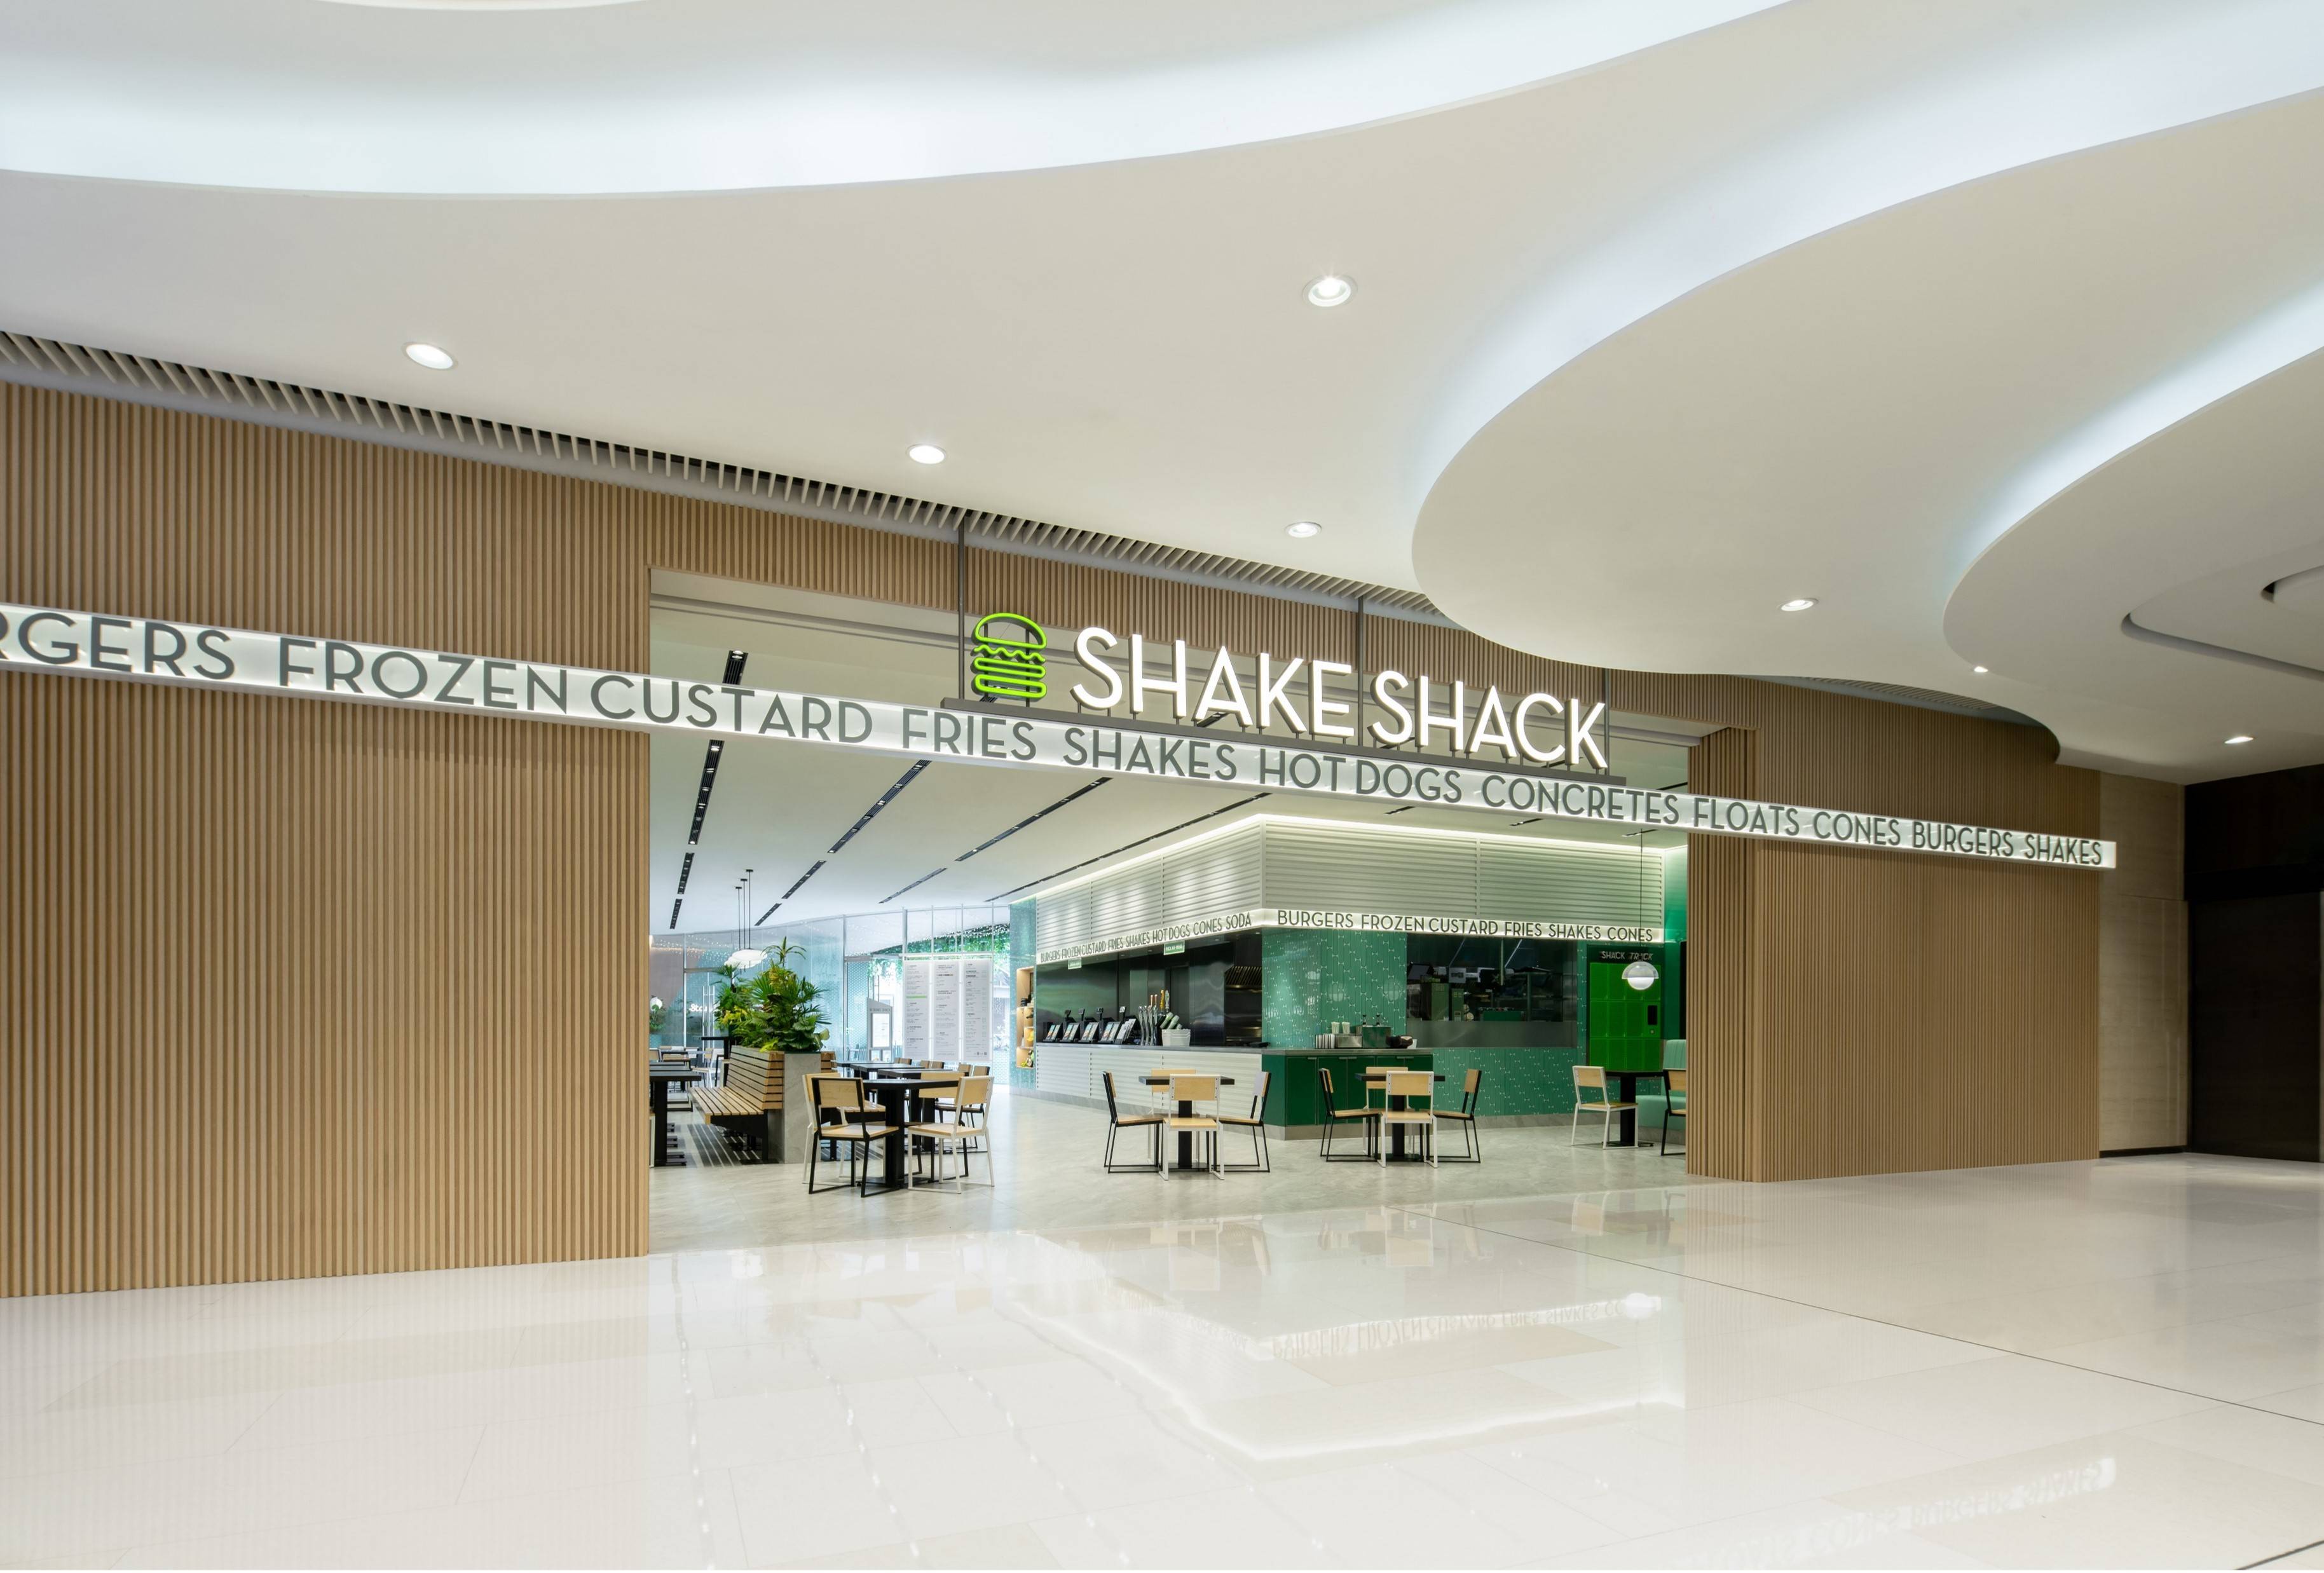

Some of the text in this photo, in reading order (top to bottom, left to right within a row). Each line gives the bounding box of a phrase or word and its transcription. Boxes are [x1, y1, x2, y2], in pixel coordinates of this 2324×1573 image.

[1070, 627, 1608, 770] SHAKE SHACK
[0, 607, 2103, 866] GERS FROZEN CUSTARD FRIES SHAKES HOT DOGS CONCRETES FLOATS CONES BURGERS SHAKES
[1041, 911, 1252, 963] BURGERS FROZEN CUSTARD FRIES SHAKES HOT DOGS CONES SODA
[1277, 909, 1653, 942] BURGERS FROZEN CUSTARD FRIES SHAKES CONES
[1602, 951, 1625, 960] SHACK
